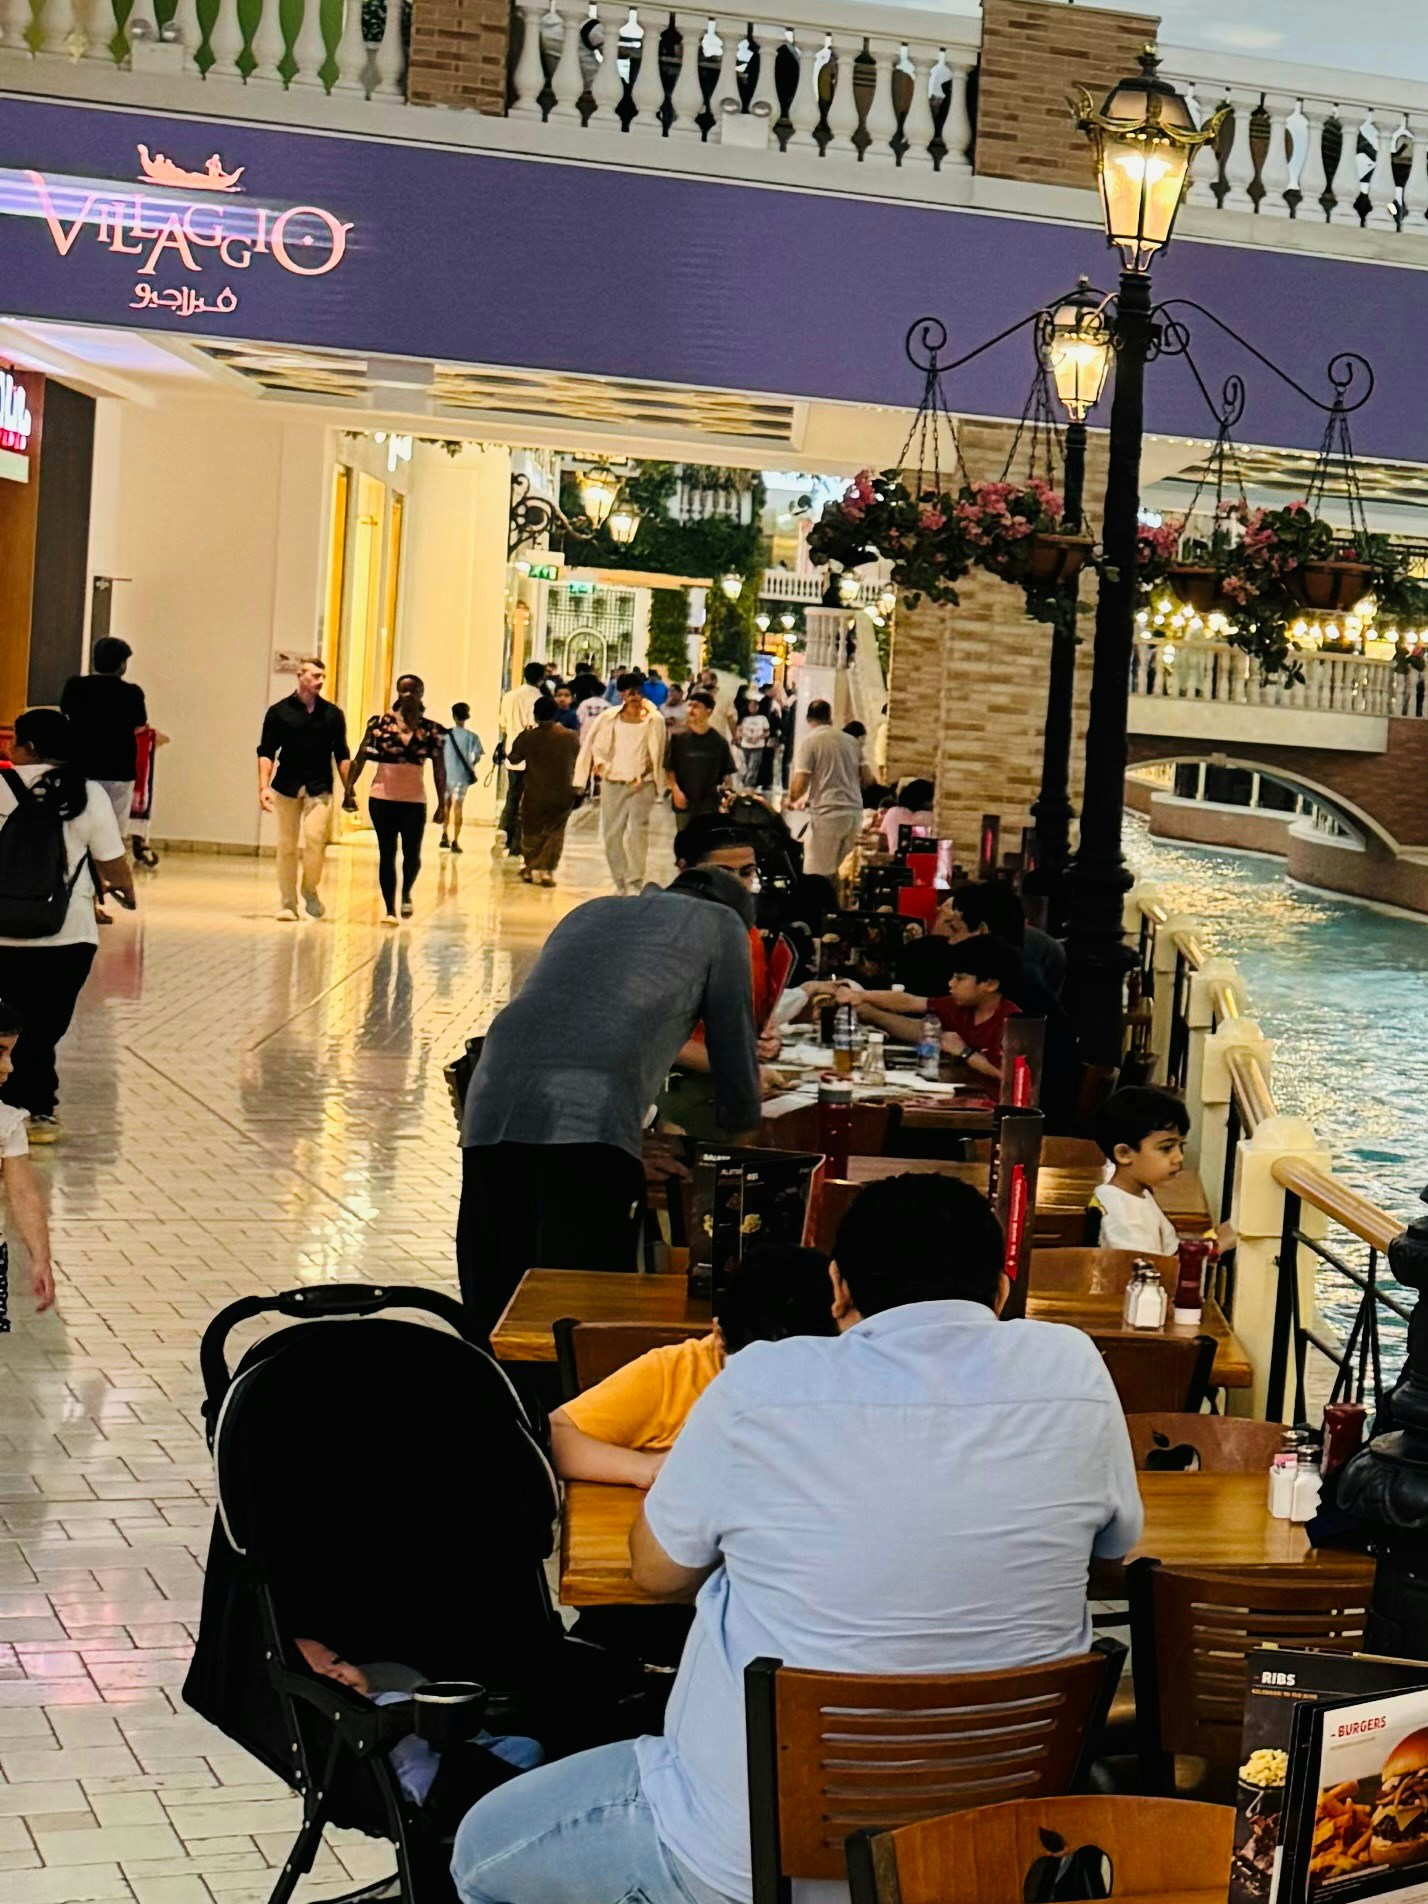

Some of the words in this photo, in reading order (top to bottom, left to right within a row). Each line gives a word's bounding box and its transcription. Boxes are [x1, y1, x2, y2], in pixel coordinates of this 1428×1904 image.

[24, 169, 354, 276] VILLAGGIO
[1261, 1671, 1297, 1687] RIBS
[1338, 1716, 1387, 1738] BURGERS
